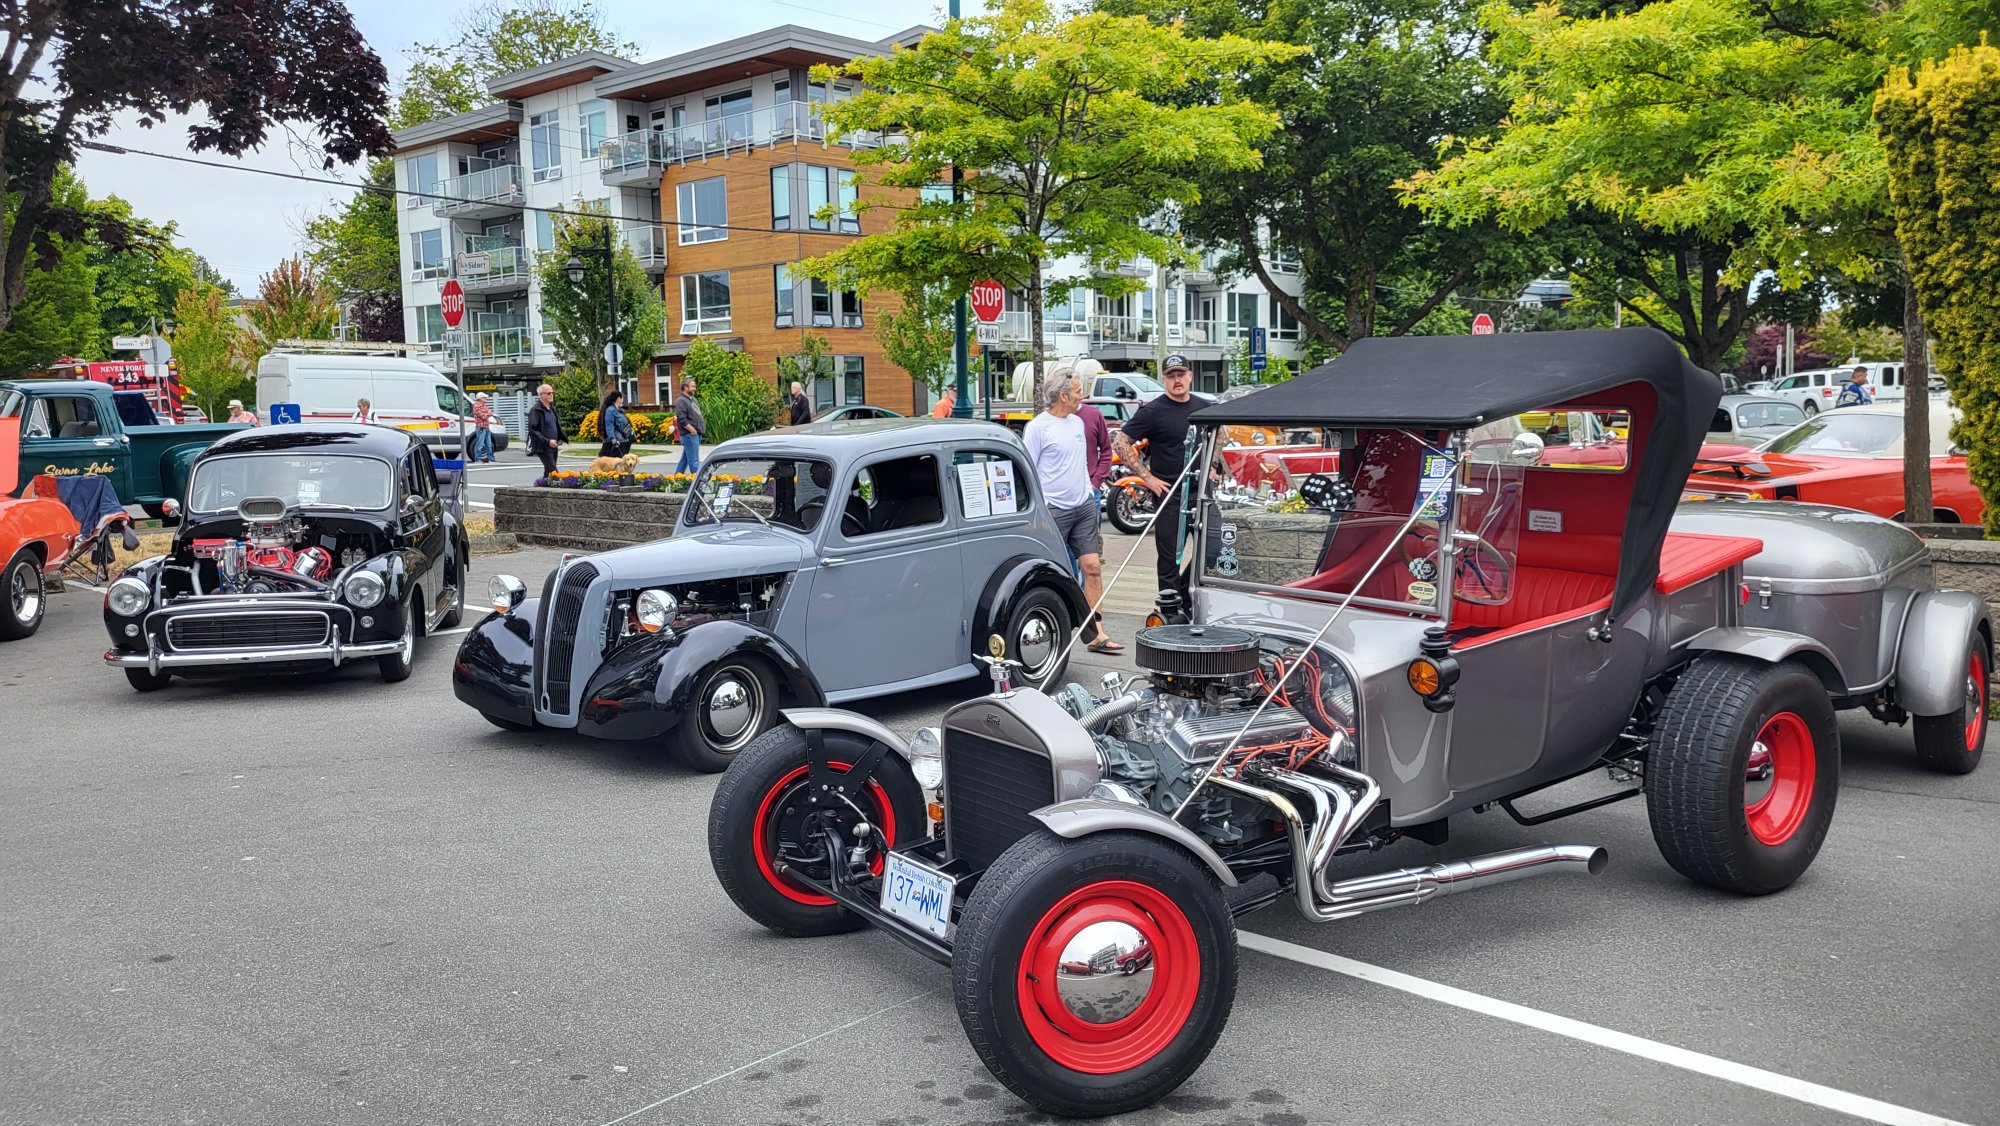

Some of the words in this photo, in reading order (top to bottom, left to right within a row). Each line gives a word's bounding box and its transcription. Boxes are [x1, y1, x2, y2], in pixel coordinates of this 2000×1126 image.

[442, 294, 463, 313] STOP
[974, 286, 1001, 307] STOP
[447, 332, 462, 344] 4-WAY
[979, 328, 998, 340] 4-WAY
[100, 365, 124, 373] NEVER
[125, 364, 145, 372] FORG
[117, 372, 139, 383] 343
[43, 464, 80, 477] Swan
[84, 462, 115, 477] Lake
[1423, 455, 1433, 476] Vote!
[888, 872, 914, 906] 137
[919, 886, 946, 924] WML
